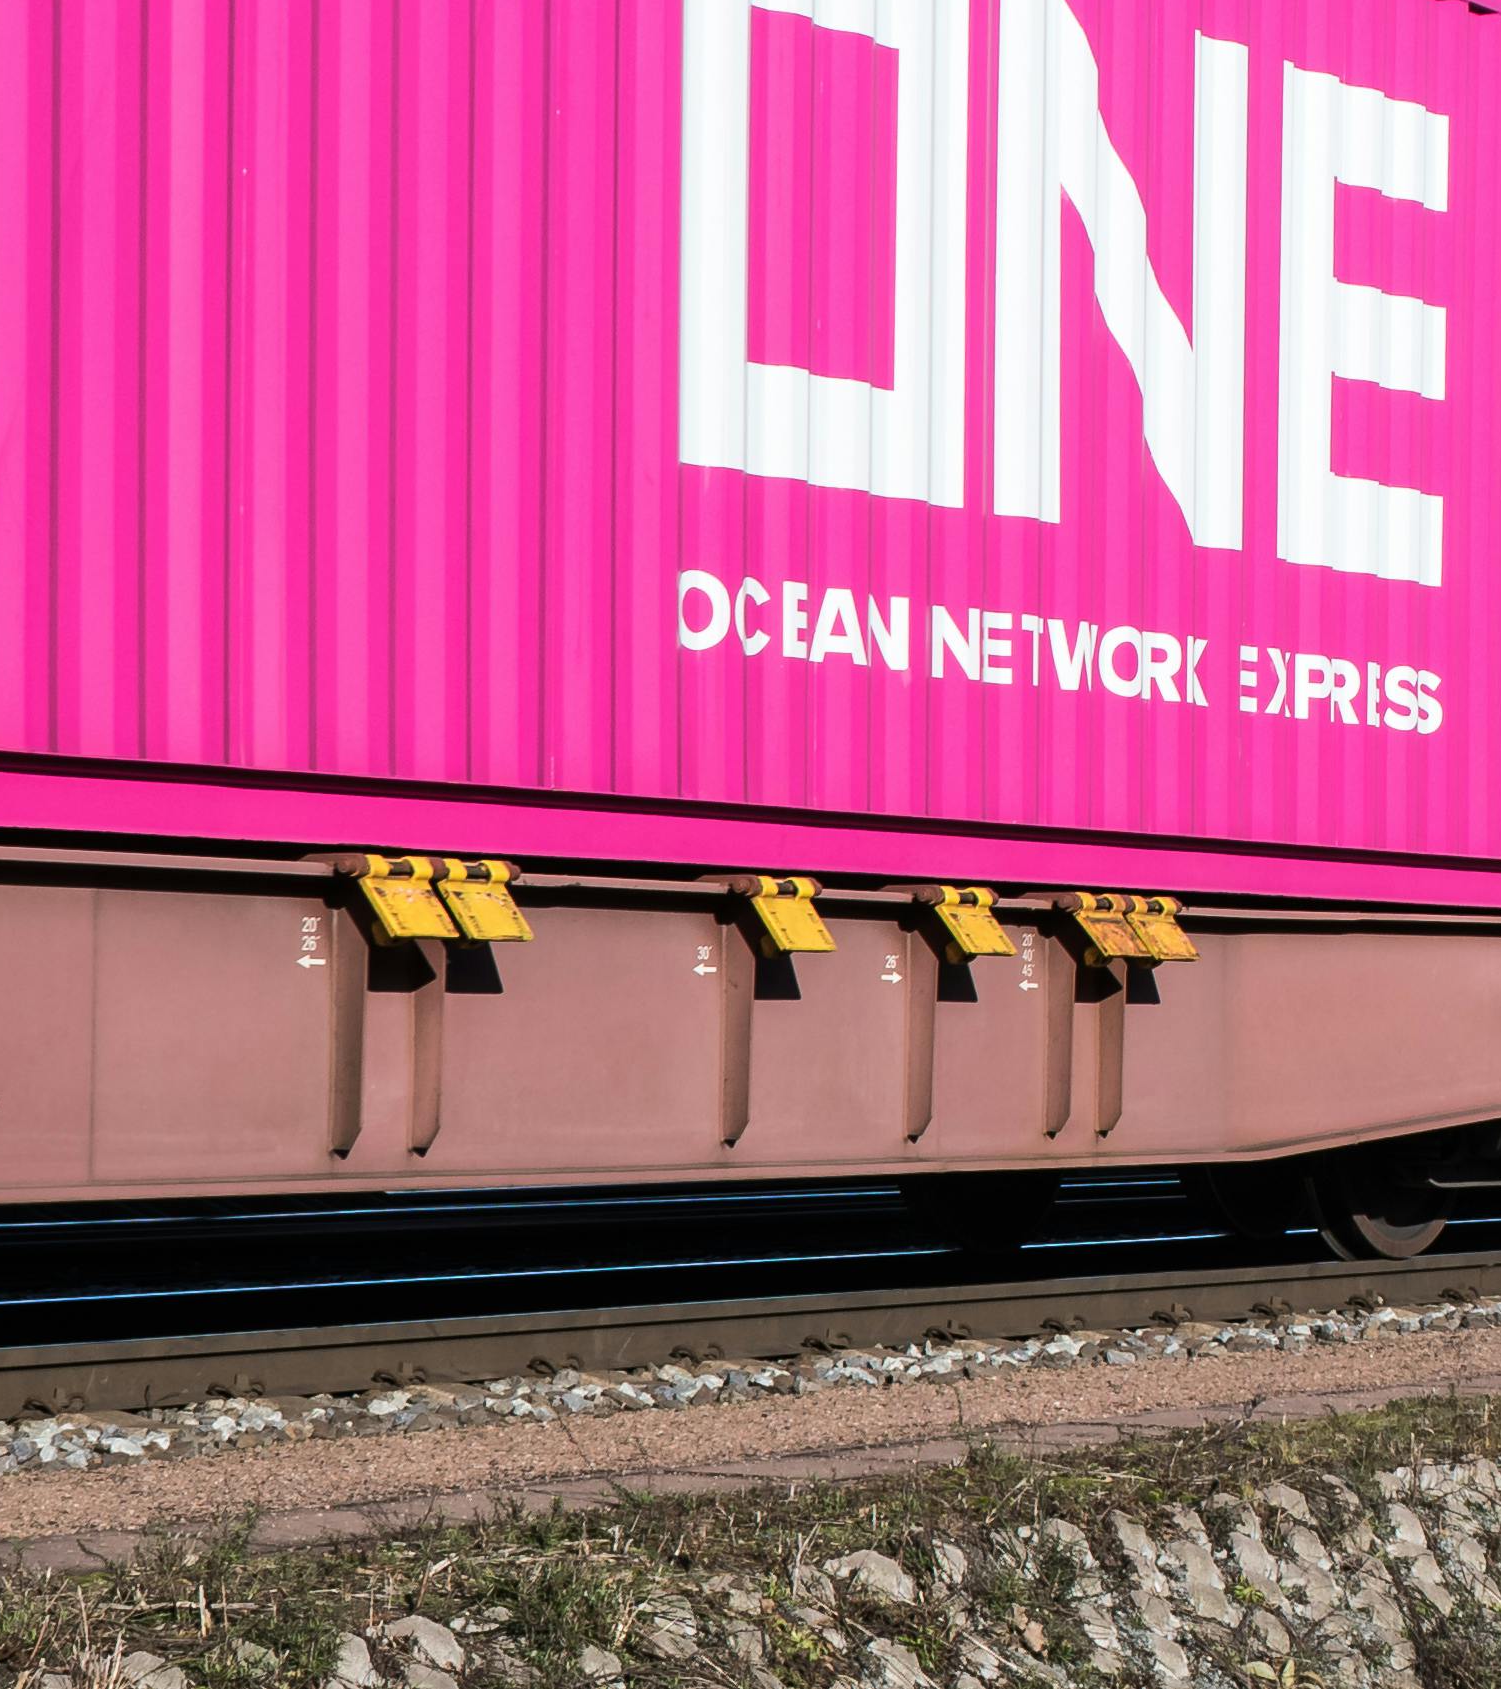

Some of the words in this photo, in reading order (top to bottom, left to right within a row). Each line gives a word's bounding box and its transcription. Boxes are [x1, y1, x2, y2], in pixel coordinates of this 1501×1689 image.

[677, 569, 910, 672] OCEAN
[932, 604, 1209, 708] NETWORK
[1239, 644, 1444, 735] EXPRESS
